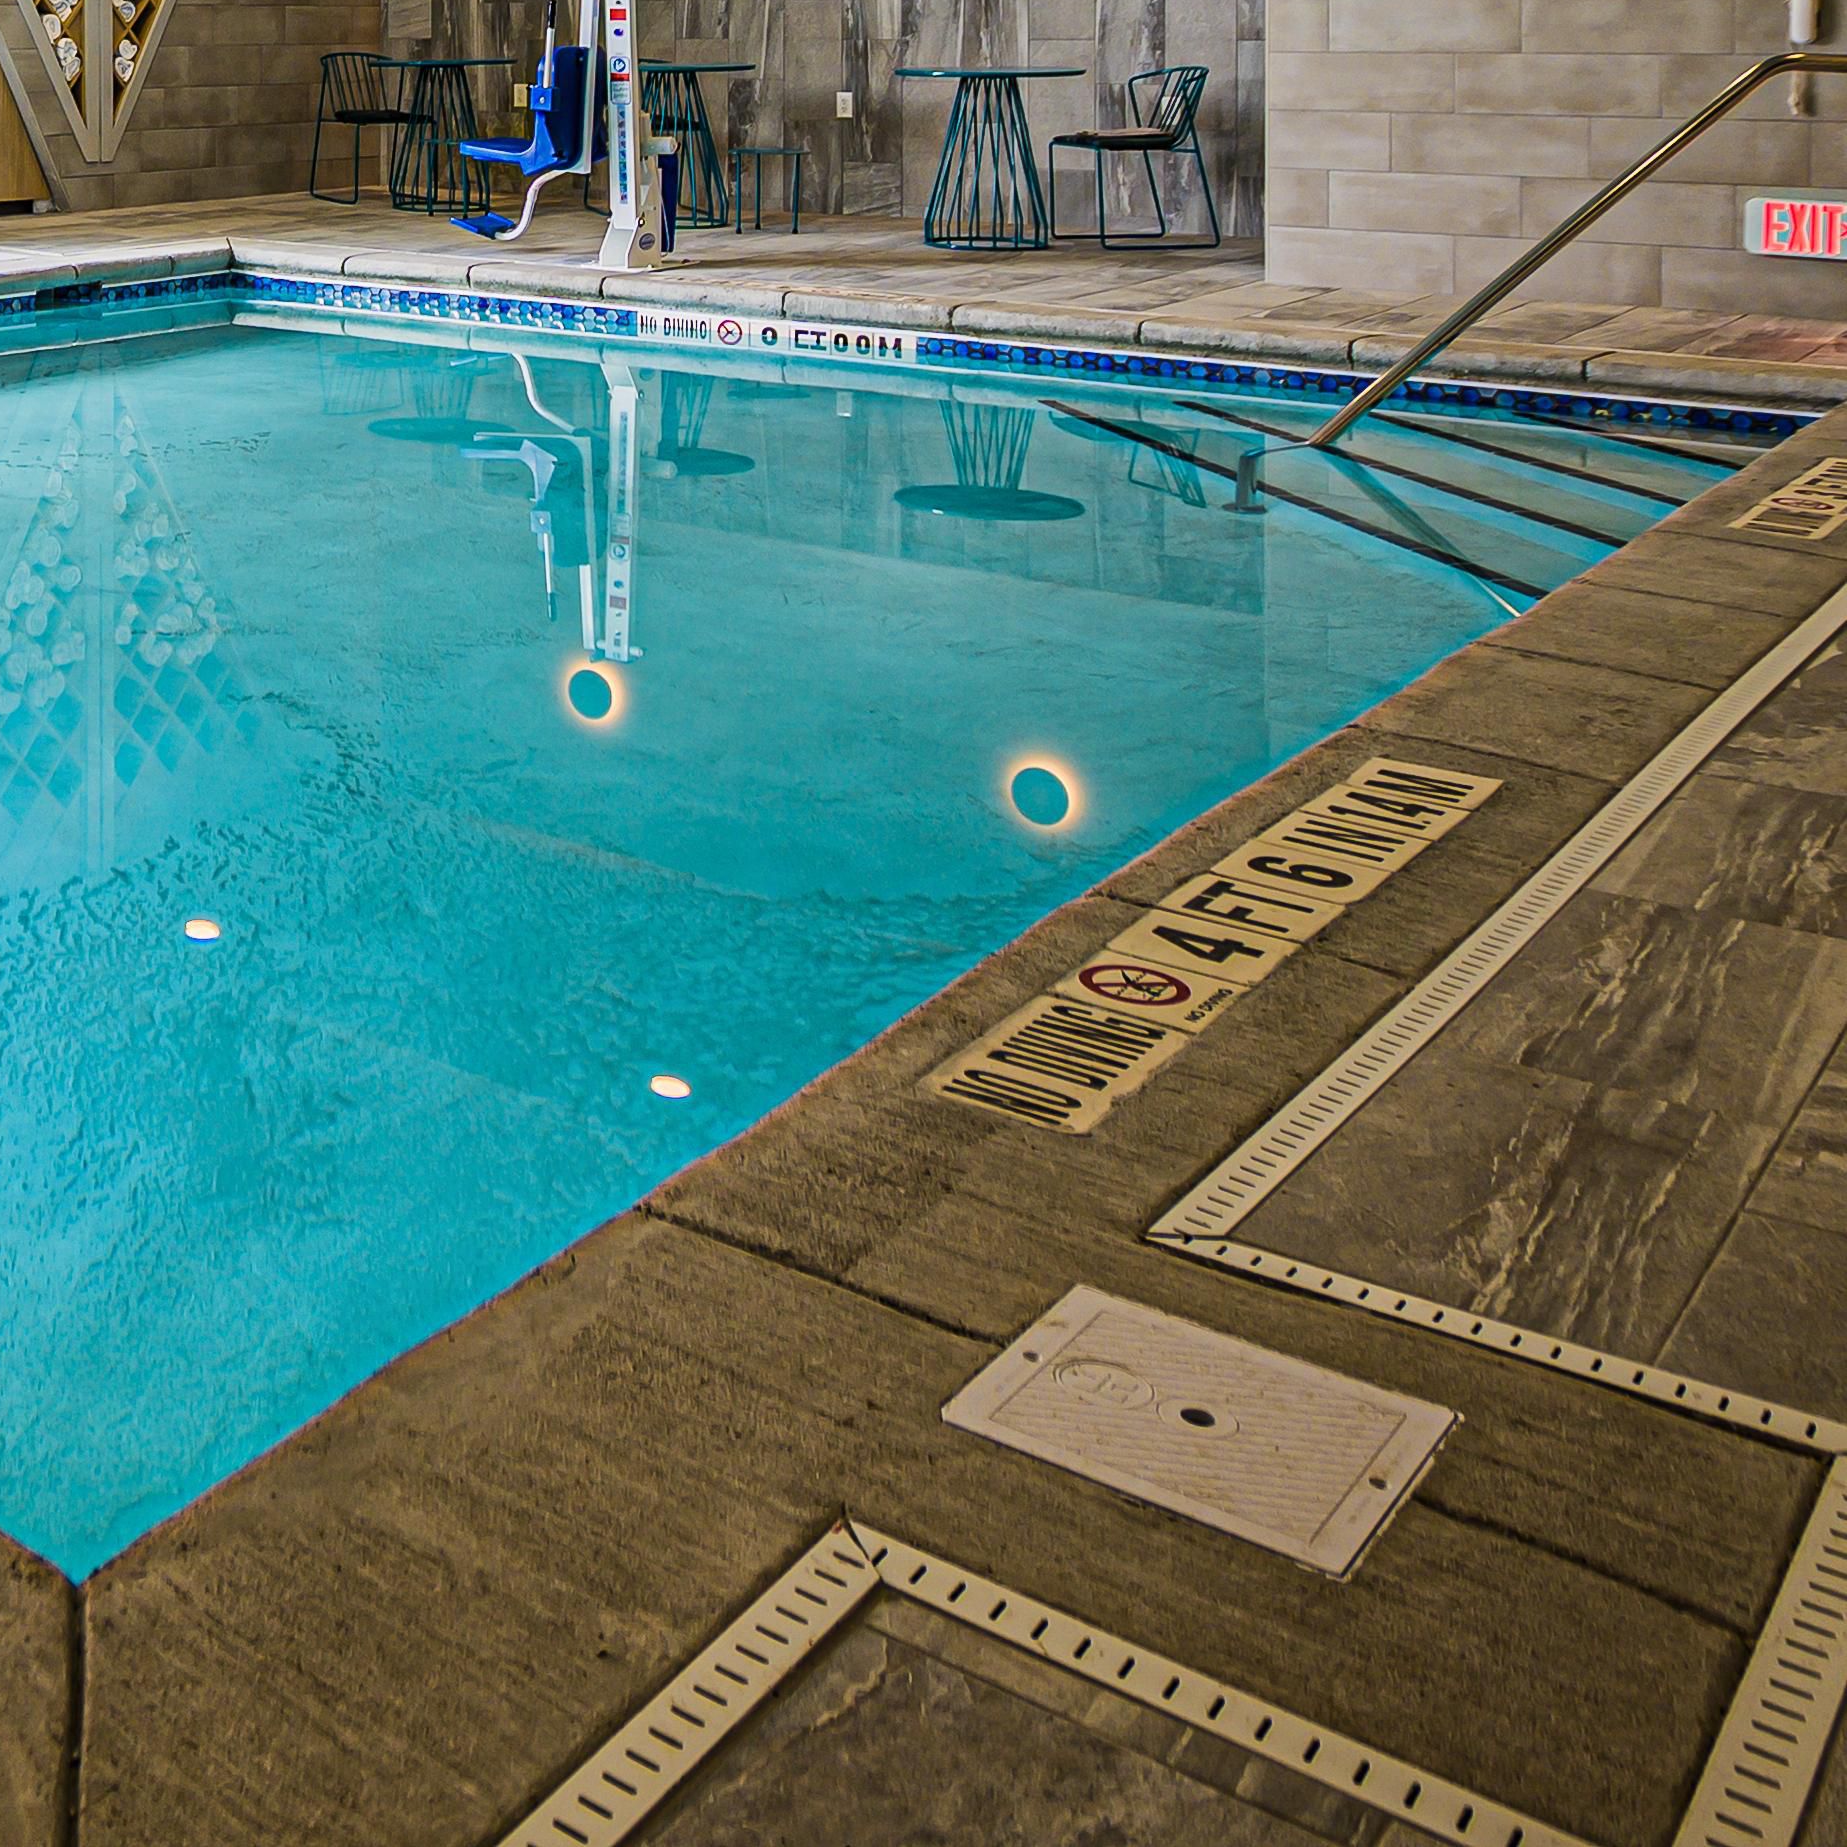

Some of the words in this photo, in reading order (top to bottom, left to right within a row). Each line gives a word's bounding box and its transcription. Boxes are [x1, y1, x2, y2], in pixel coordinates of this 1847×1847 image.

[1762, 202, 1845, 255] EXIT
[1363, 769, 1474, 804] M
[1282, 819, 1406, 862] IN
[1247, 856, 1353, 888] 6
[1182, 880, 1314, 933] FT
[1152, 925, 1265, 963] 4
[986, 1006, 1166, 1092] DIVING
[942, 1069, 1082, 1126] NO
